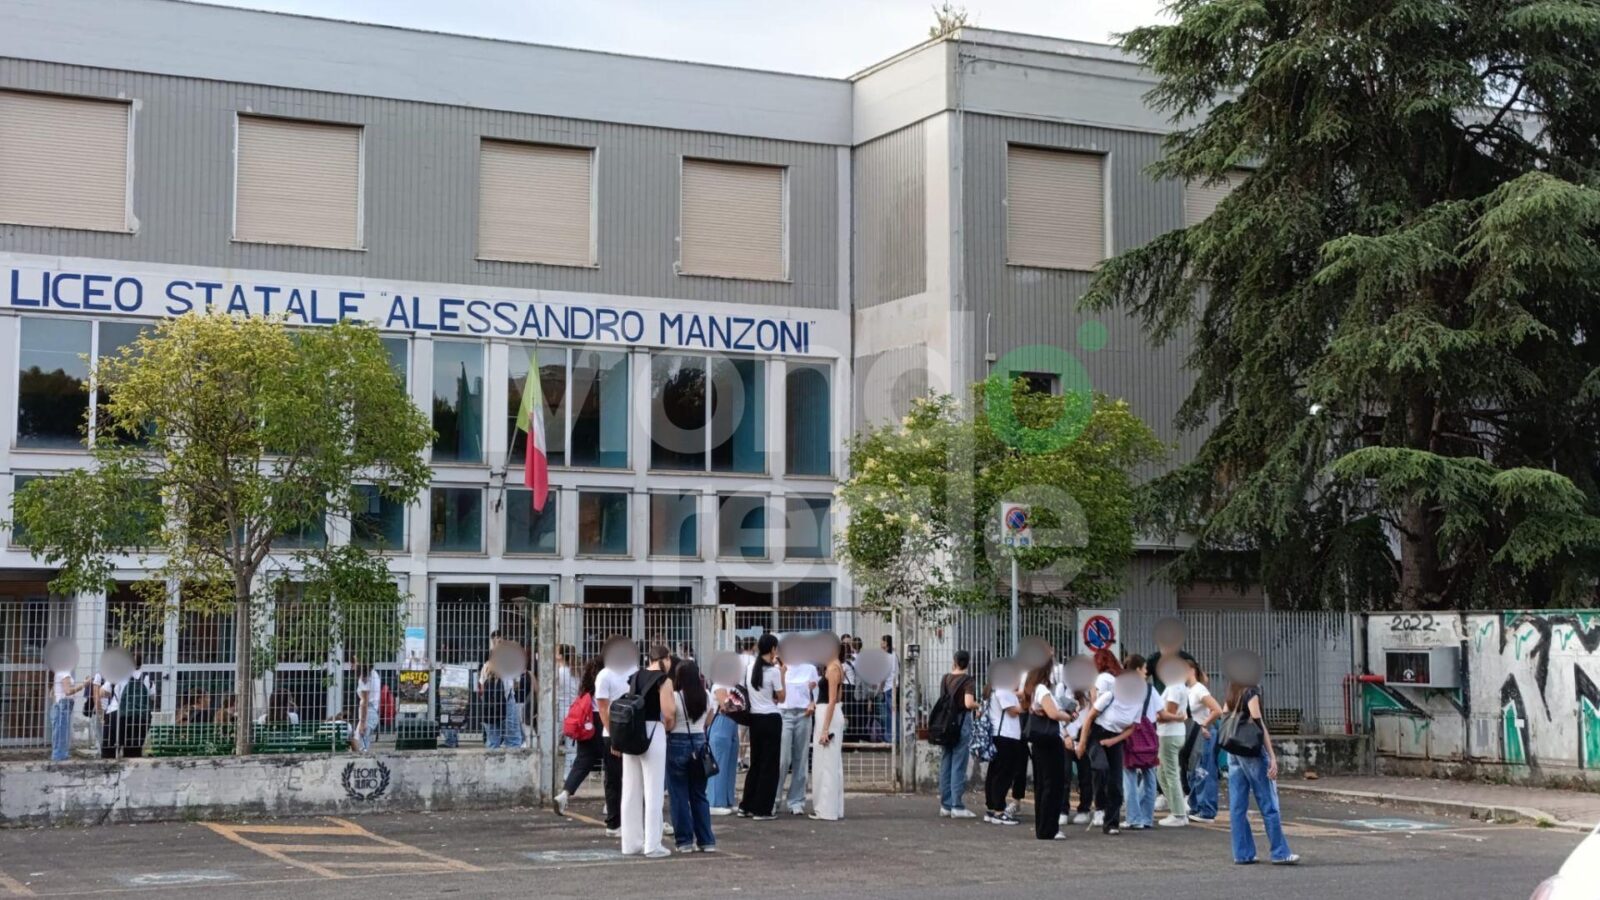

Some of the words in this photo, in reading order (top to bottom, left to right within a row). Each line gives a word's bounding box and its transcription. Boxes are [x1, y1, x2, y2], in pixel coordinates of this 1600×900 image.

[11, 269, 143, 312] LICEO
[165, 280, 366, 324] STATALE
[400, 671, 429, 684] WASTED
